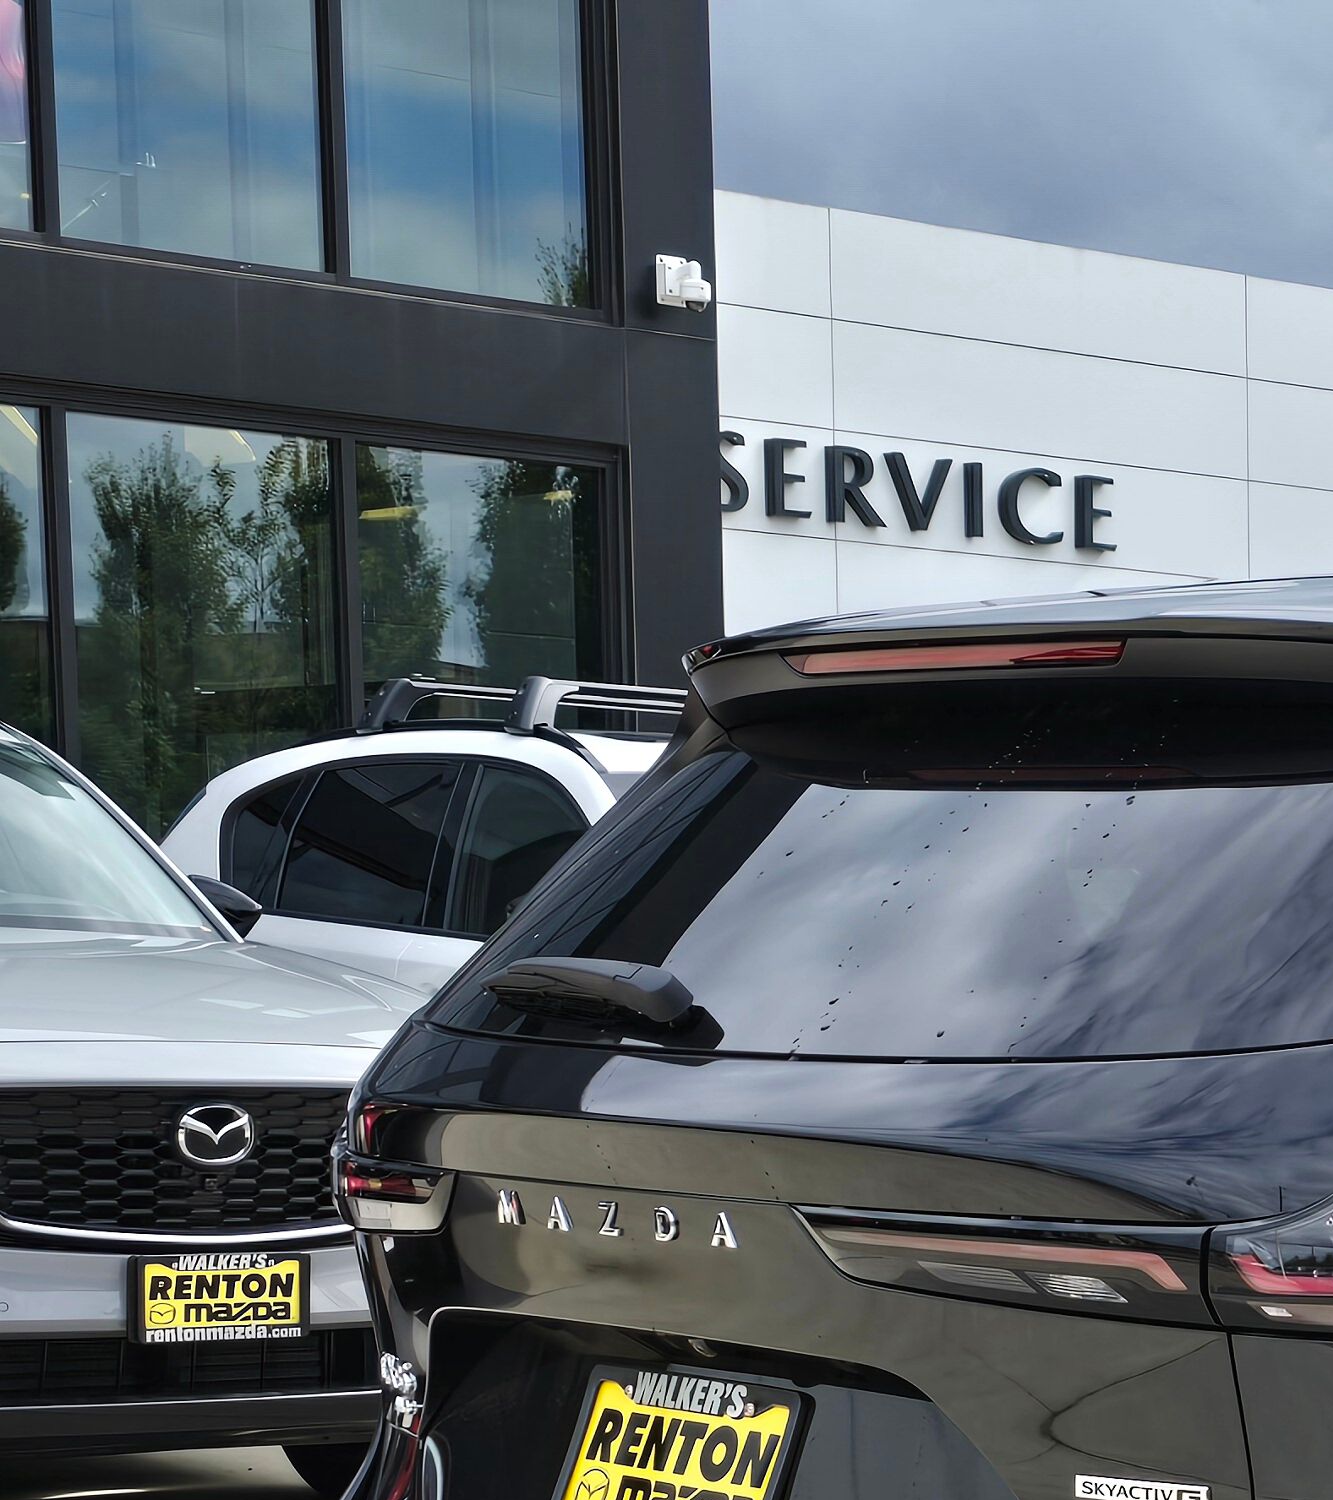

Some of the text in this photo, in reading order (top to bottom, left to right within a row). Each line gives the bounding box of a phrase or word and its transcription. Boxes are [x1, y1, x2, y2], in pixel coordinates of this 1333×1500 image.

[719, 430, 1117, 552] SERVICE
[498, 1188, 738, 1249] MAZDA
[178, 1253, 268, 1271] WALKER'S
[150, 1273, 294, 1300] RENTON
[145, 1324, 301, 1342] rentonmazda.com
[632, 1371, 748, 1418] WALKER'S
[585, 1408, 781, 1488] RENTON
